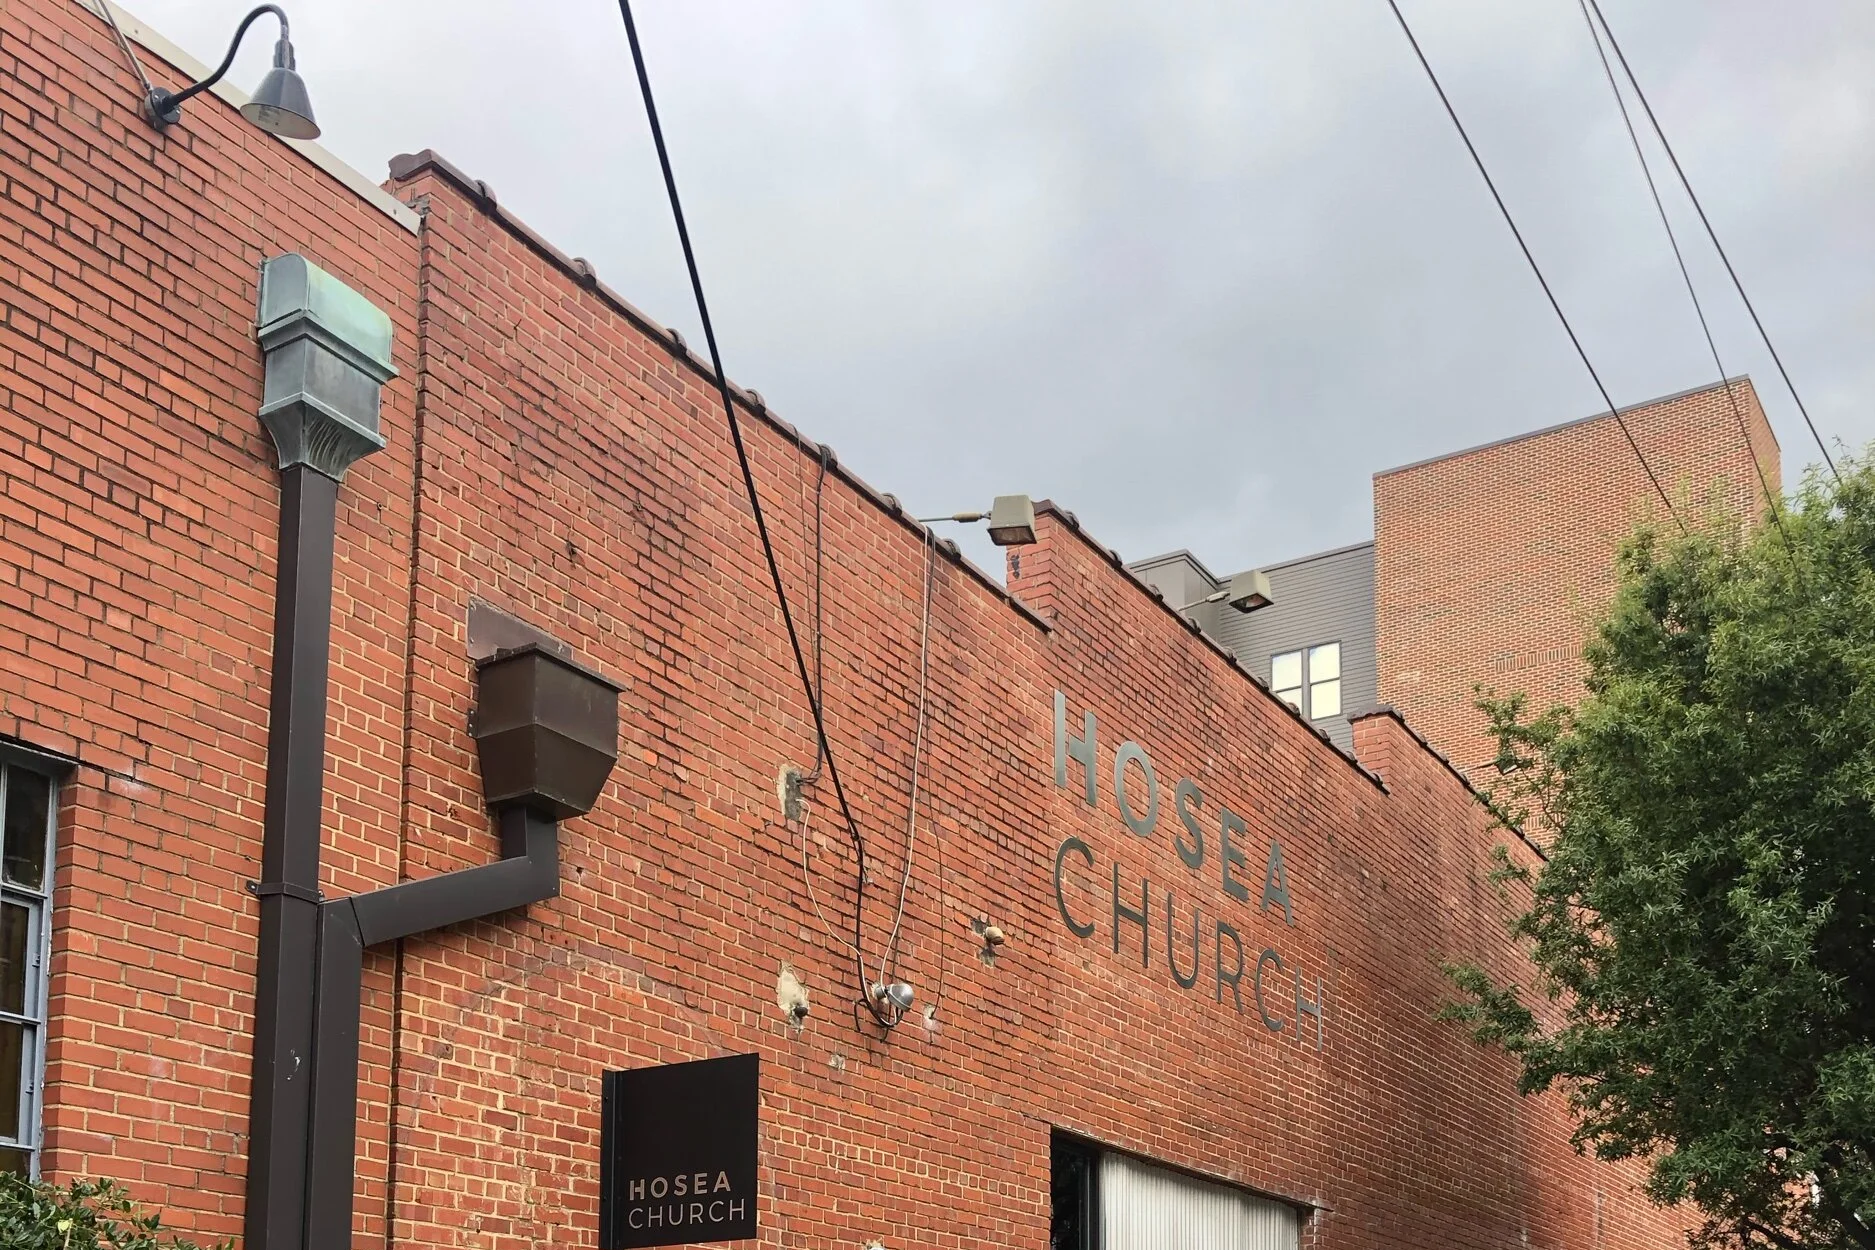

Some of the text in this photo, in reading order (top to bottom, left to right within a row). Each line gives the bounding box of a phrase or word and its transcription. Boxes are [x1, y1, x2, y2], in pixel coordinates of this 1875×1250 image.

[1054, 690, 1294, 926] HOSEA
[1054, 837, 1323, 1051] CHURCH
[628, 1198, 745, 1229] CHURCH
[629, 1170, 731, 1201] HOSEA
